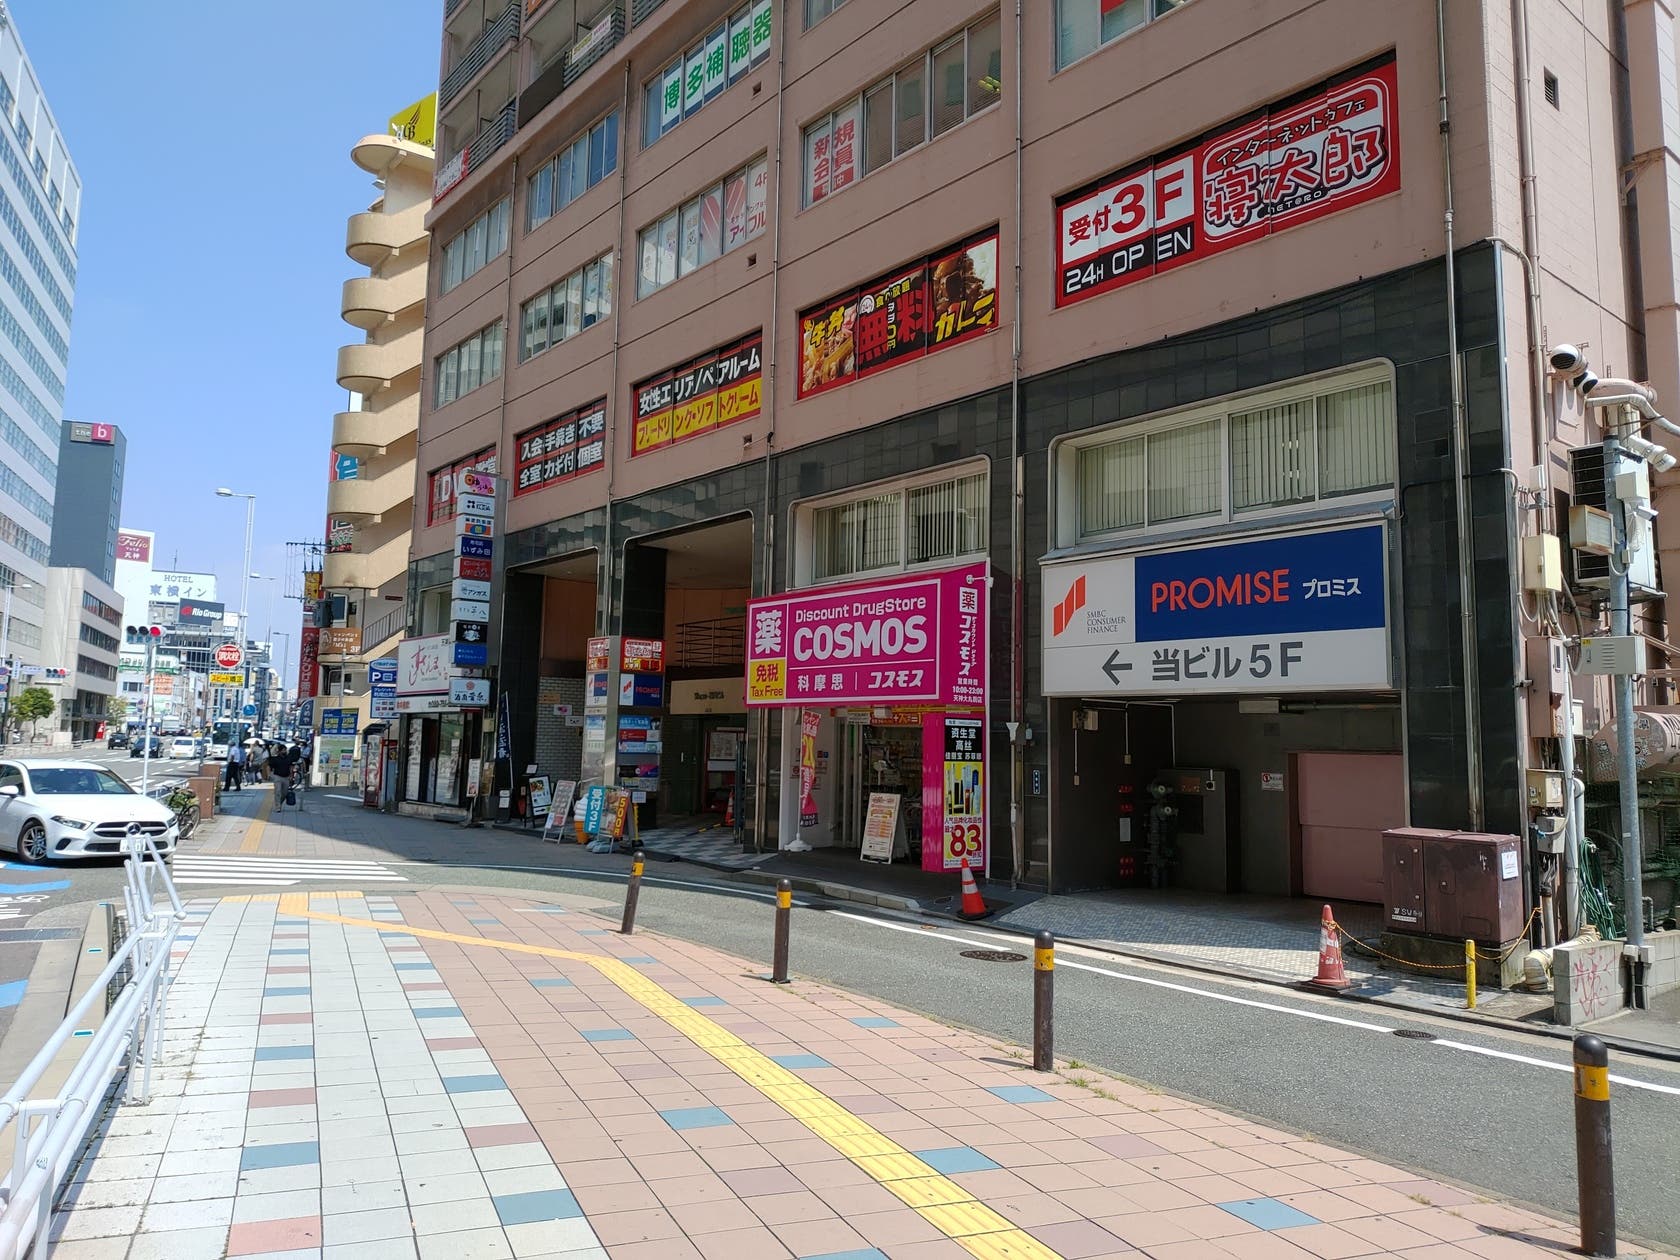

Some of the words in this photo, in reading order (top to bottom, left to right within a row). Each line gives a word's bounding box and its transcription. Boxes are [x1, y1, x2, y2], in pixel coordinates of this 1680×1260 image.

[665, 6, 771, 114] 博多補聴器
[1217, 99, 1366, 164] インターネットカフェ
[1204, 127, 1388, 228] 寝太郎
[1112, 226, 1192, 275] OPEN
[859, 281, 934, 364] 無料
[522, 409, 604, 463] 入会手続き不要
[519, 440, 603, 490] 全室カギ付個室
[149, 583, 207, 598] 東横イン
[164, 574, 194, 584] HOTEL
[1151, 569, 1290, 613] PROMISE
[1302, 577, 1362, 600] プロミス
[796, 605, 849, 623] Discount
[852, 596, 927, 617] DrugStore
[961, 590, 975, 610] 薬
[1087, 610, 1107, 619] SMBC
[755, 610, 782, 654] 薬
[793, 615, 928, 661] COSMOS
[1087, 617, 1127, 626] CONSUMER
[1087, 625, 1119, 633] FINANCE
[959, 615, 972, 676] コスモス
[1152, 641, 1304, 681] 当ビル5F
[372, 672, 381, 682] P
[756, 664, 778, 682] 免税
[797, 673, 844, 692] 科摩思
[868, 670, 924, 689] コスモス
[751, 686, 764, 697] Tax
[764, 685, 784, 697] Free
[588, 788, 604, 832] 受付3F
